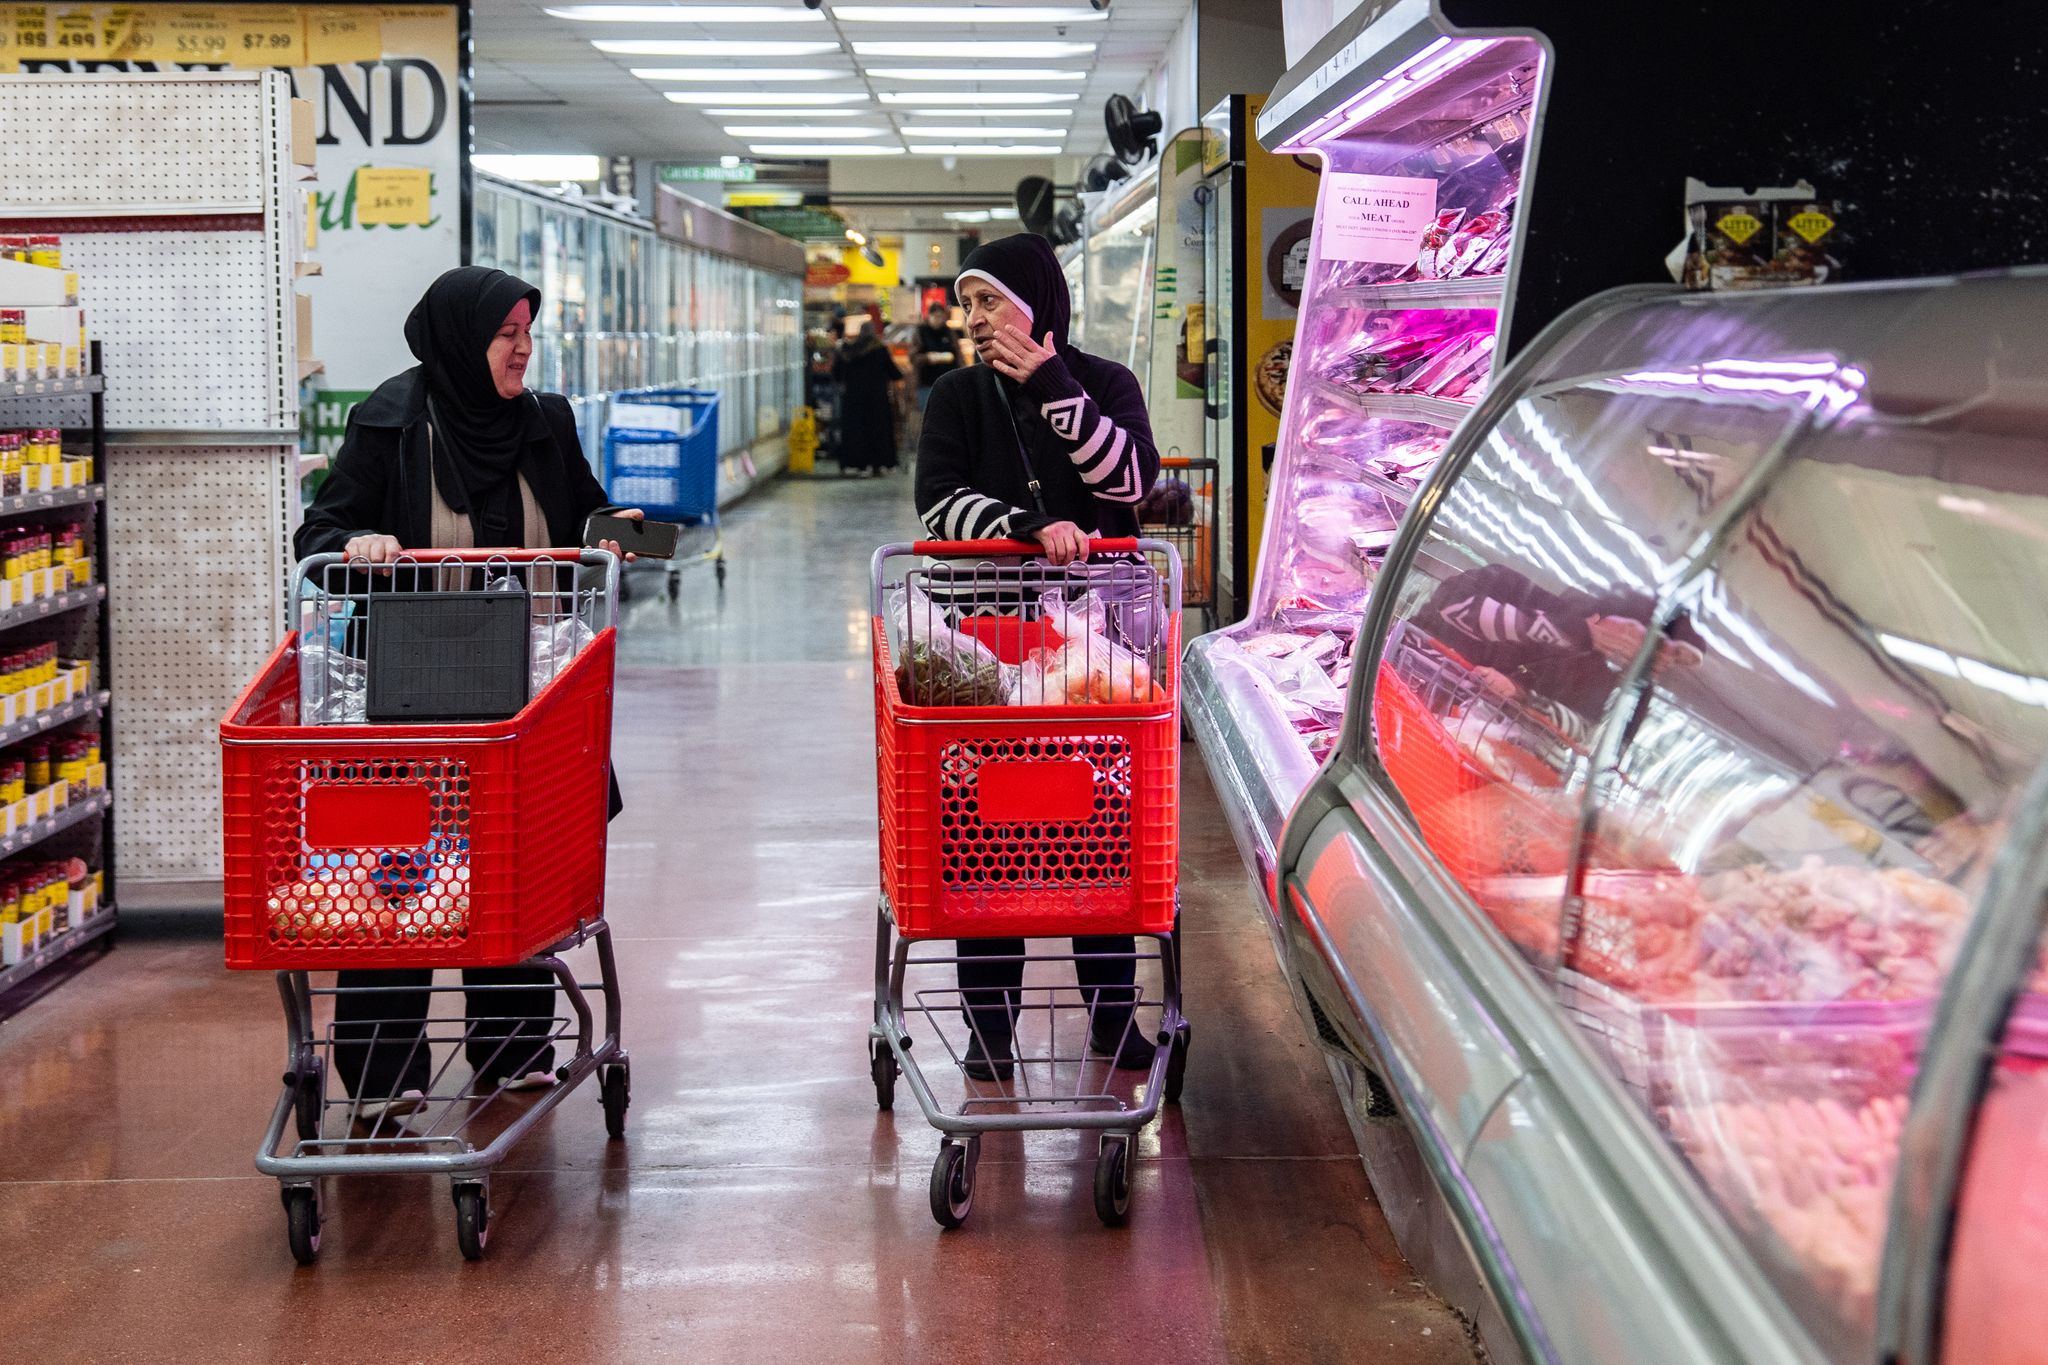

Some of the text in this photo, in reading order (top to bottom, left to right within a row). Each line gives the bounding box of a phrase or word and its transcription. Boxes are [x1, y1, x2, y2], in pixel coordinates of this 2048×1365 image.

[243, 32, 291, 49] $7.99
[1342, 195, 1410, 209] CALL AHEAD
[1361, 212, 1392, 223] MEAT
